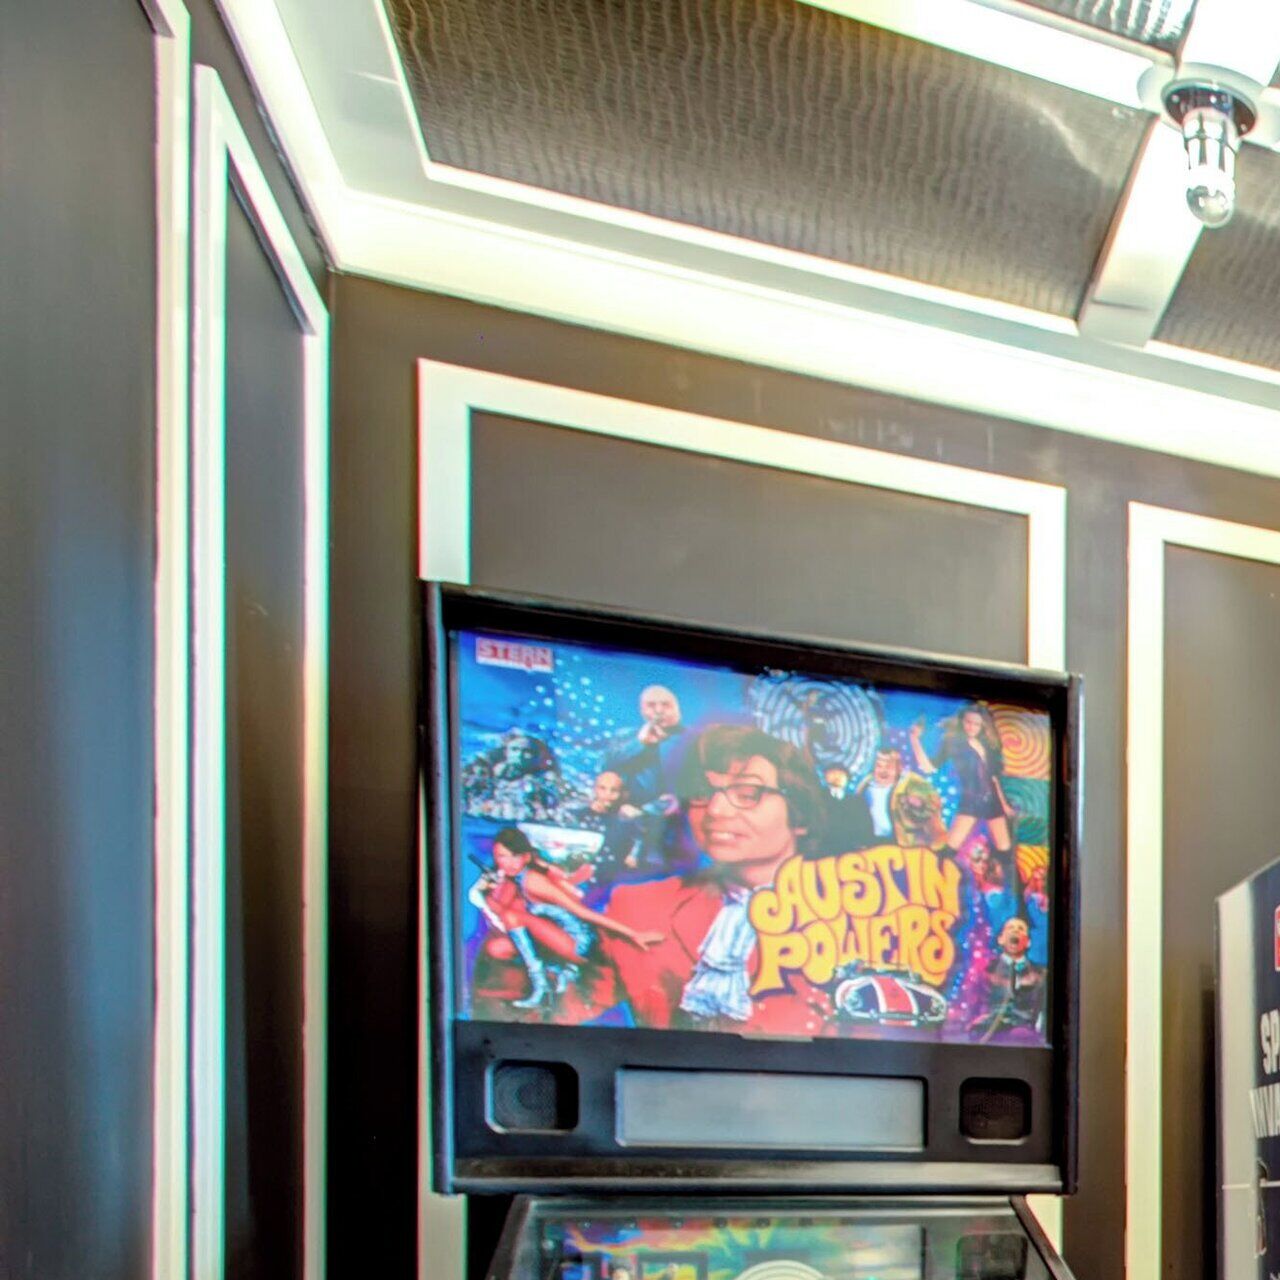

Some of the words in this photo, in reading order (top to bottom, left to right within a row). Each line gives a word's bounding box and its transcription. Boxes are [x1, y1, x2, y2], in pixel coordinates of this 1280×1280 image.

[476, 638, 553, 668] STERN
[750, 845, 961, 934] AUSTIN
[750, 904, 956, 995] POWERS
